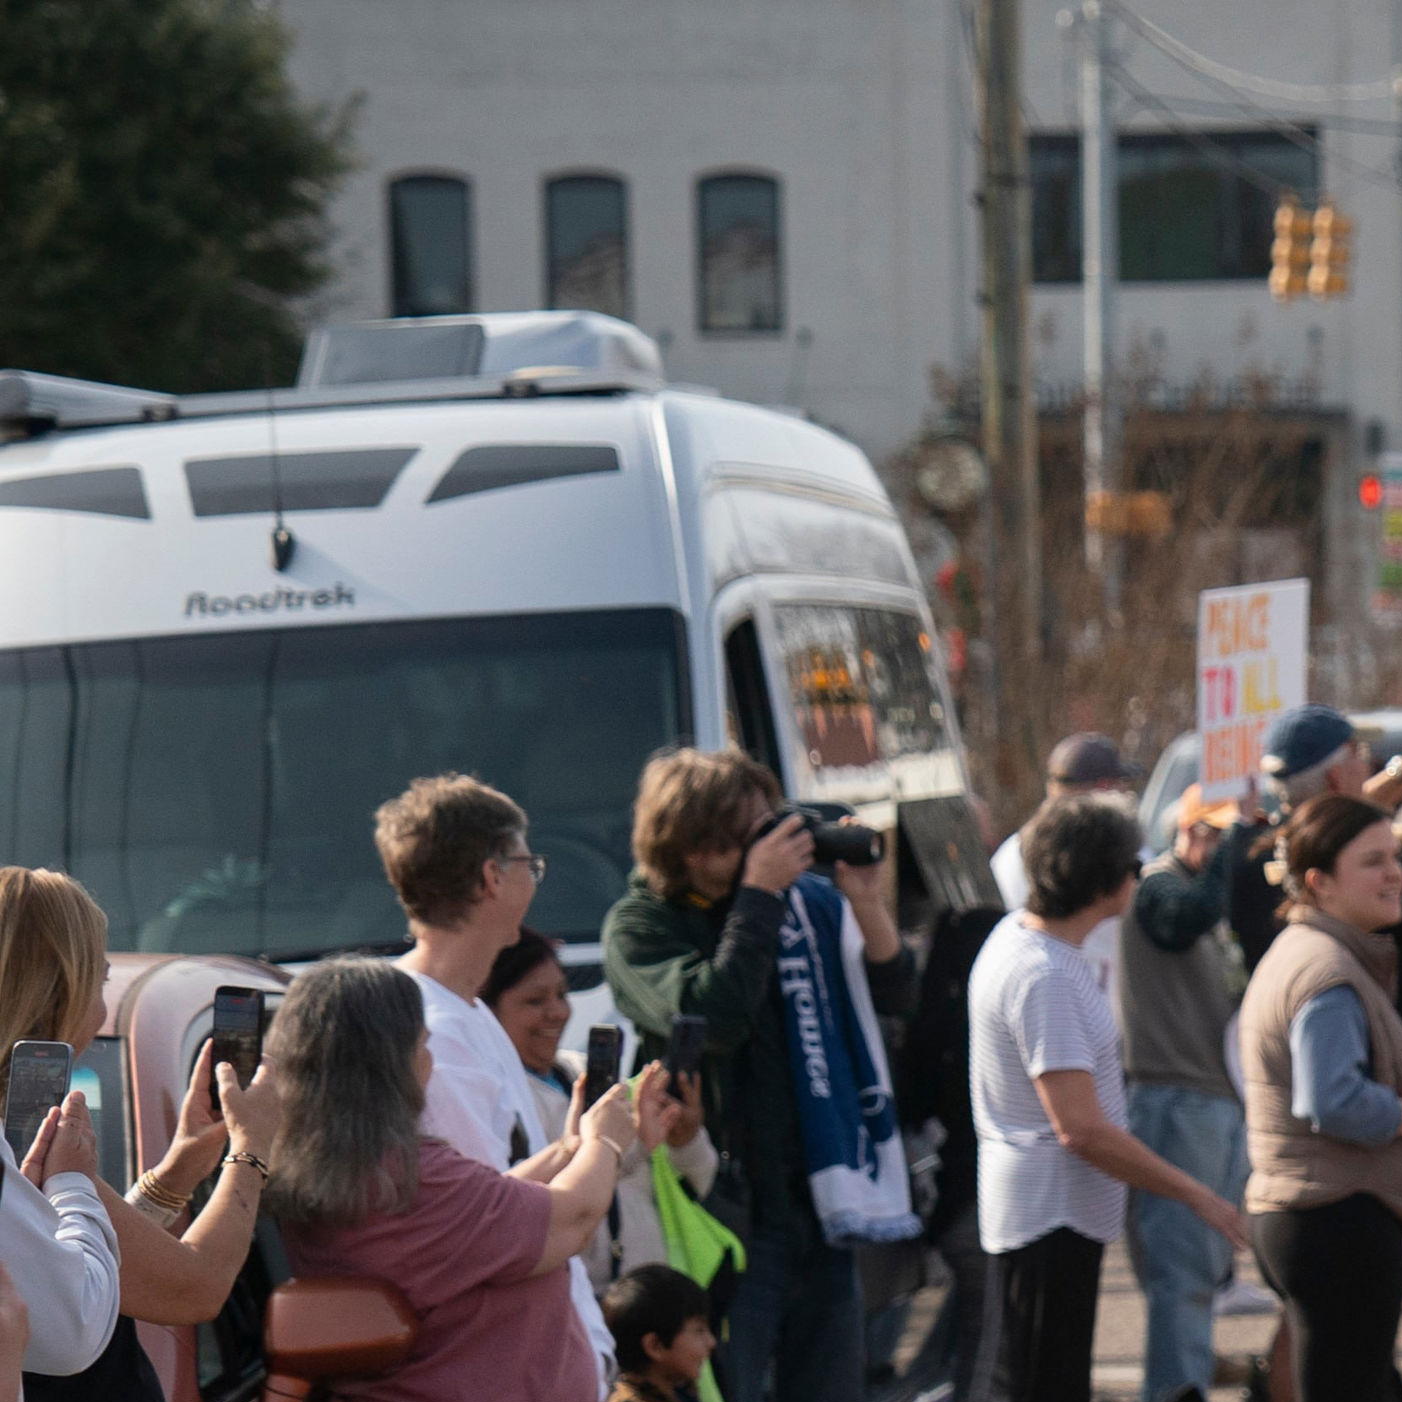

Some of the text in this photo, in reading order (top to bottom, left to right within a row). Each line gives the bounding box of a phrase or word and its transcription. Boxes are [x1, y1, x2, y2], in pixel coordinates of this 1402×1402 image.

[185, 582, 356, 618] Roadtrek
[1205, 593, 1270, 656] PEACE
[1202, 655, 1284, 722] TO ALL
